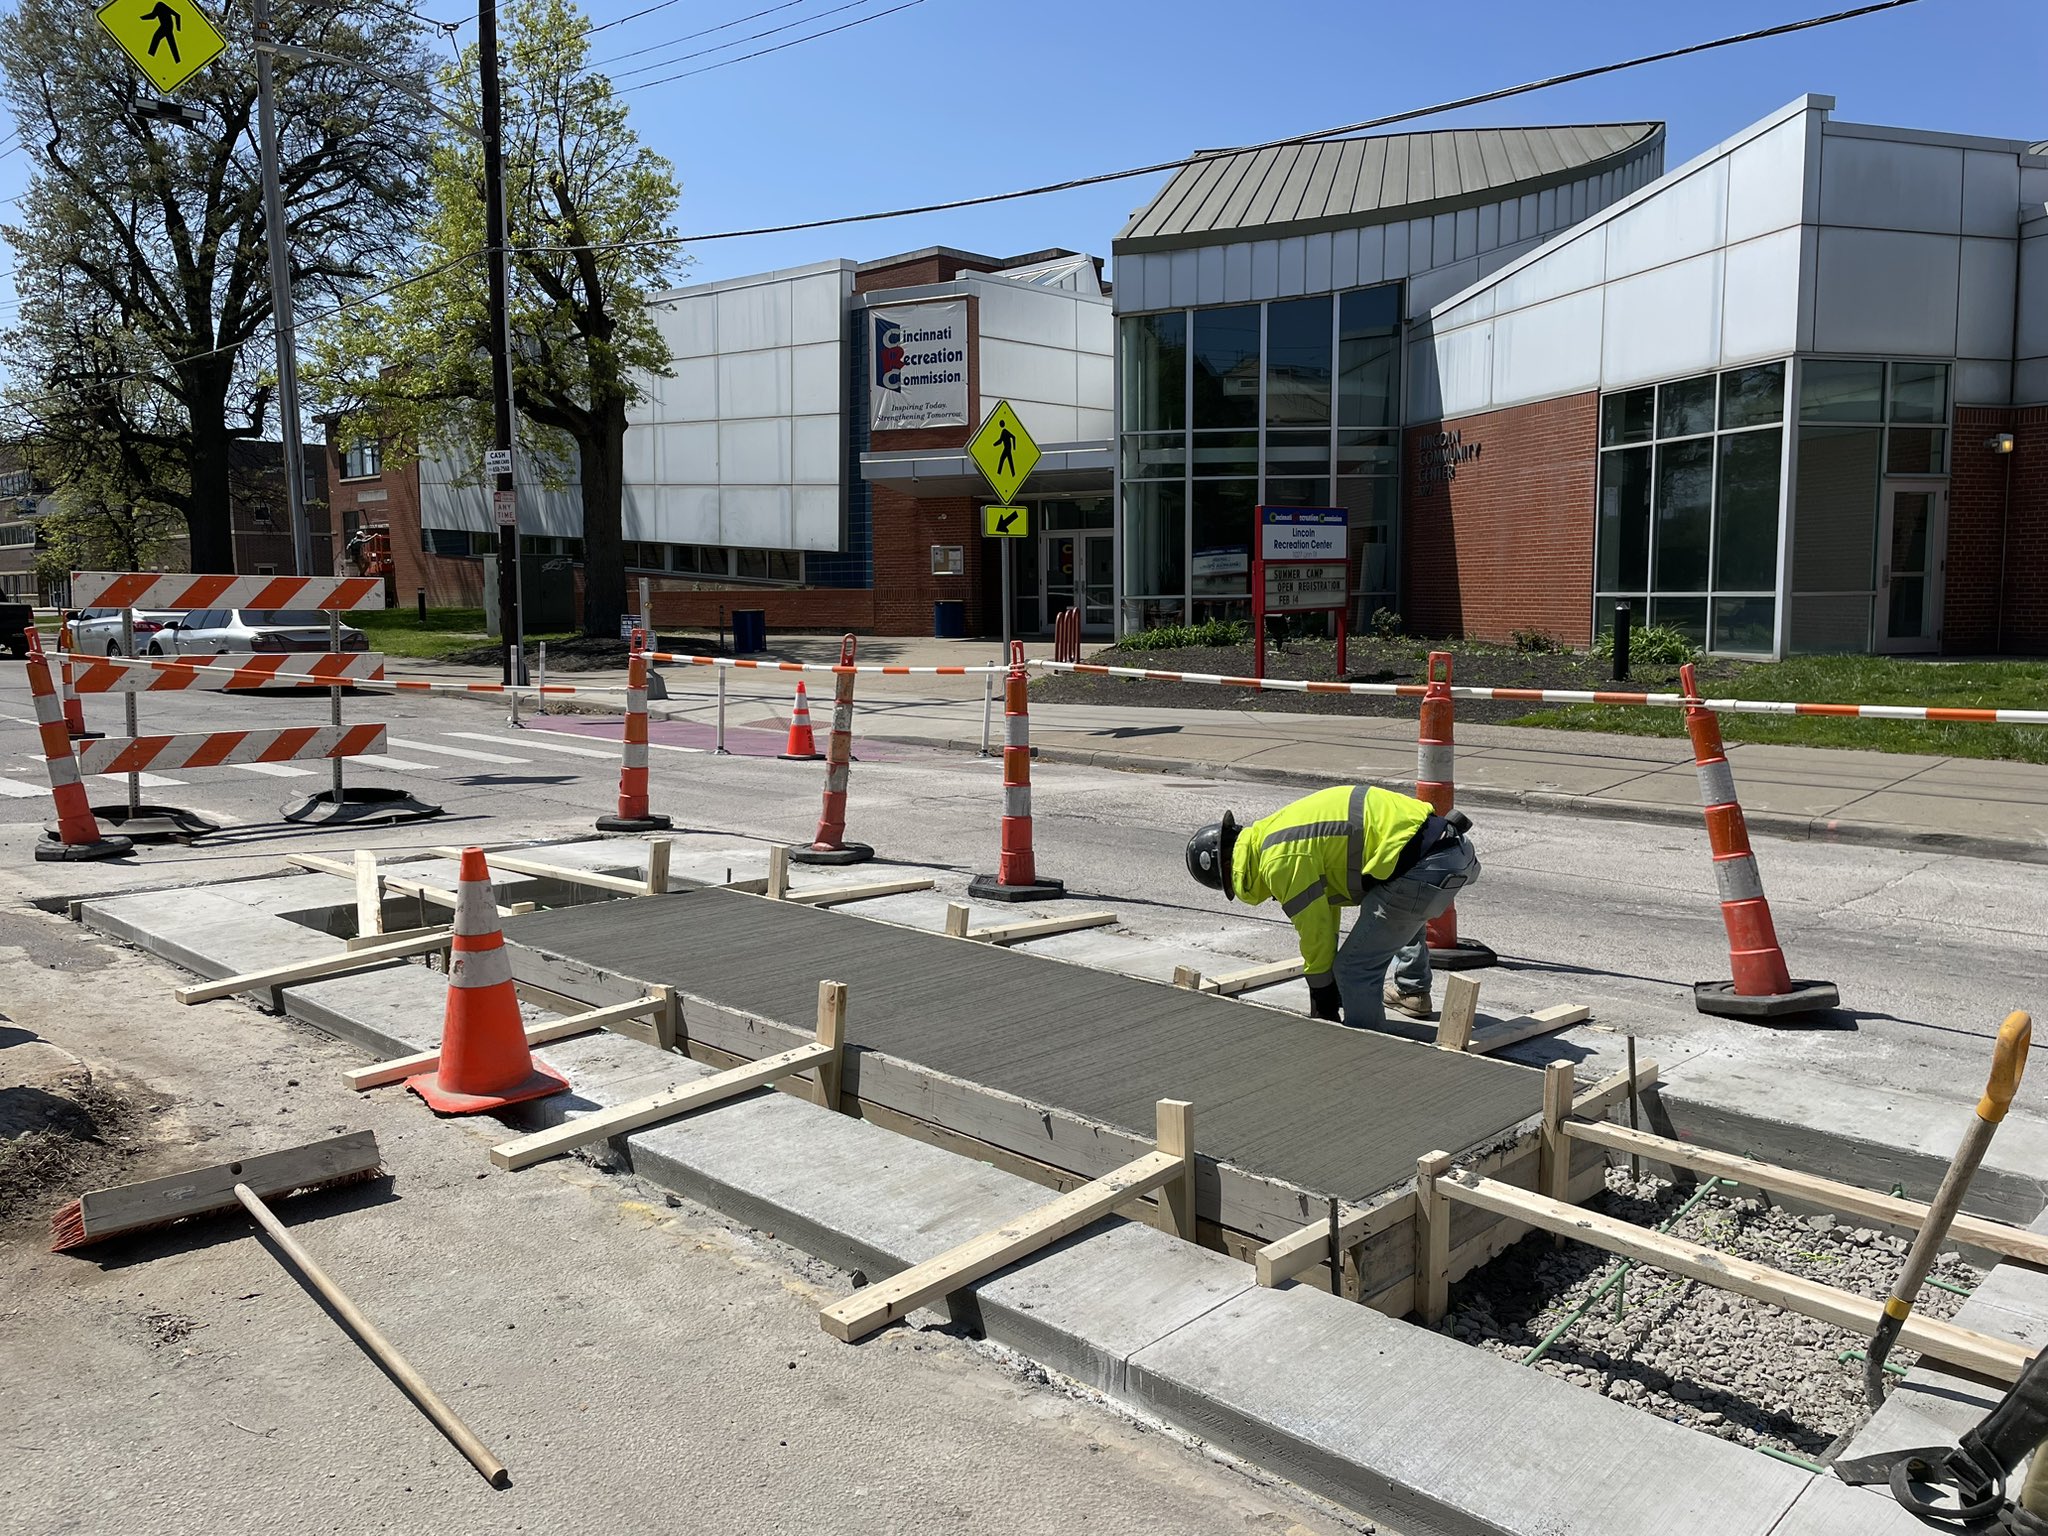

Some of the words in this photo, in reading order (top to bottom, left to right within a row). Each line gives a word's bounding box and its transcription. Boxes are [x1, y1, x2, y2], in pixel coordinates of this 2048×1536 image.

[883, 326, 952, 349] Cincinnati
[881, 346, 963, 374] Recreation
[883, 368, 961, 389] Commission
[891, 404, 924, 412] Inspiring
[1420, 443, 1478, 465] COMMUNITY
[1292, 528, 1315, 537] Lincoln
[1273, 539, 1310, 549] Recreation
[1311, 540, 1333, 549] Center
[1274, 569, 1300, 580] SUMMER
[1306, 568, 1323, 578] CAMP
[1278, 582, 1293, 592] OPEN
[1298, 581, 1340, 591] REGISTRATION
[1279, 595, 1290, 605] FEB
[1293, 595, 1299, 604] 14
